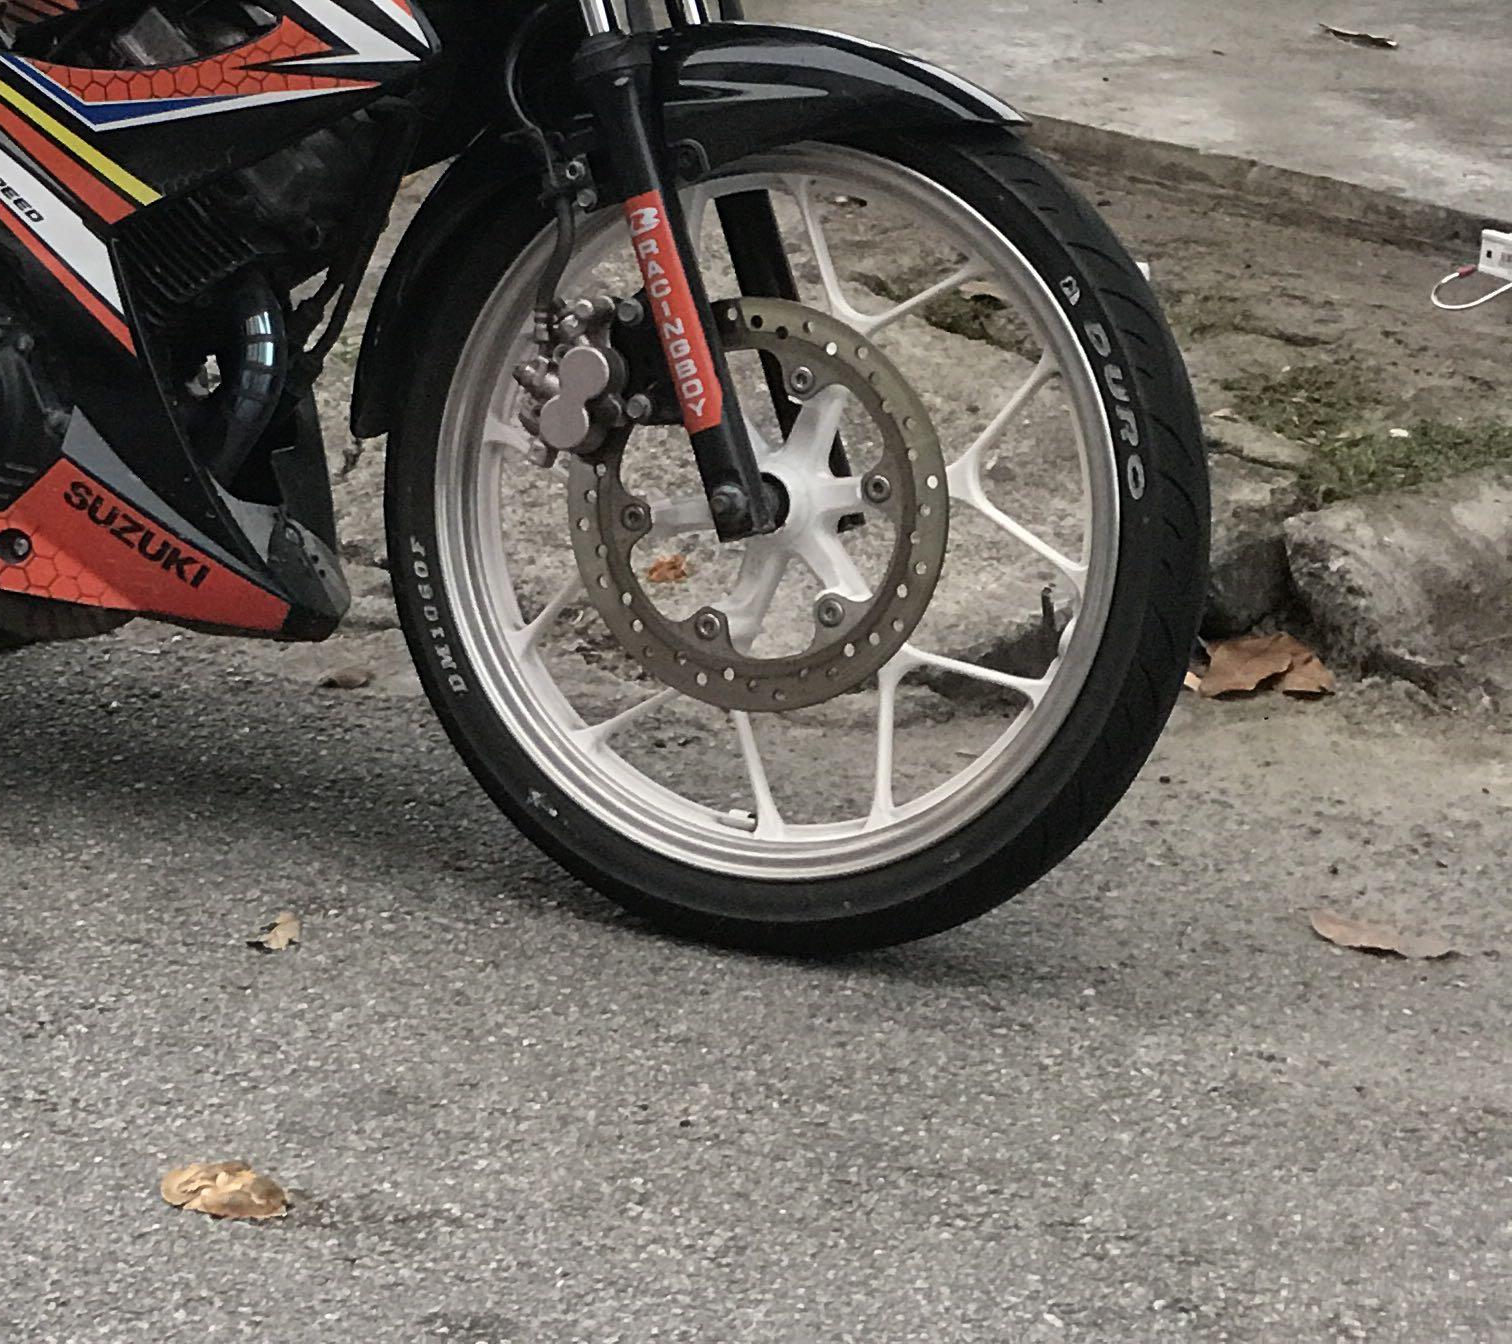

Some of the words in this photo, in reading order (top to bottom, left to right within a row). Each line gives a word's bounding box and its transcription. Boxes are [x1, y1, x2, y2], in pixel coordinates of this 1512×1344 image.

[638, 238, 707, 417] RACINGBOY
[1083, 321, 1146, 501] DURO
[63, 480, 210, 589] SUZUKI
